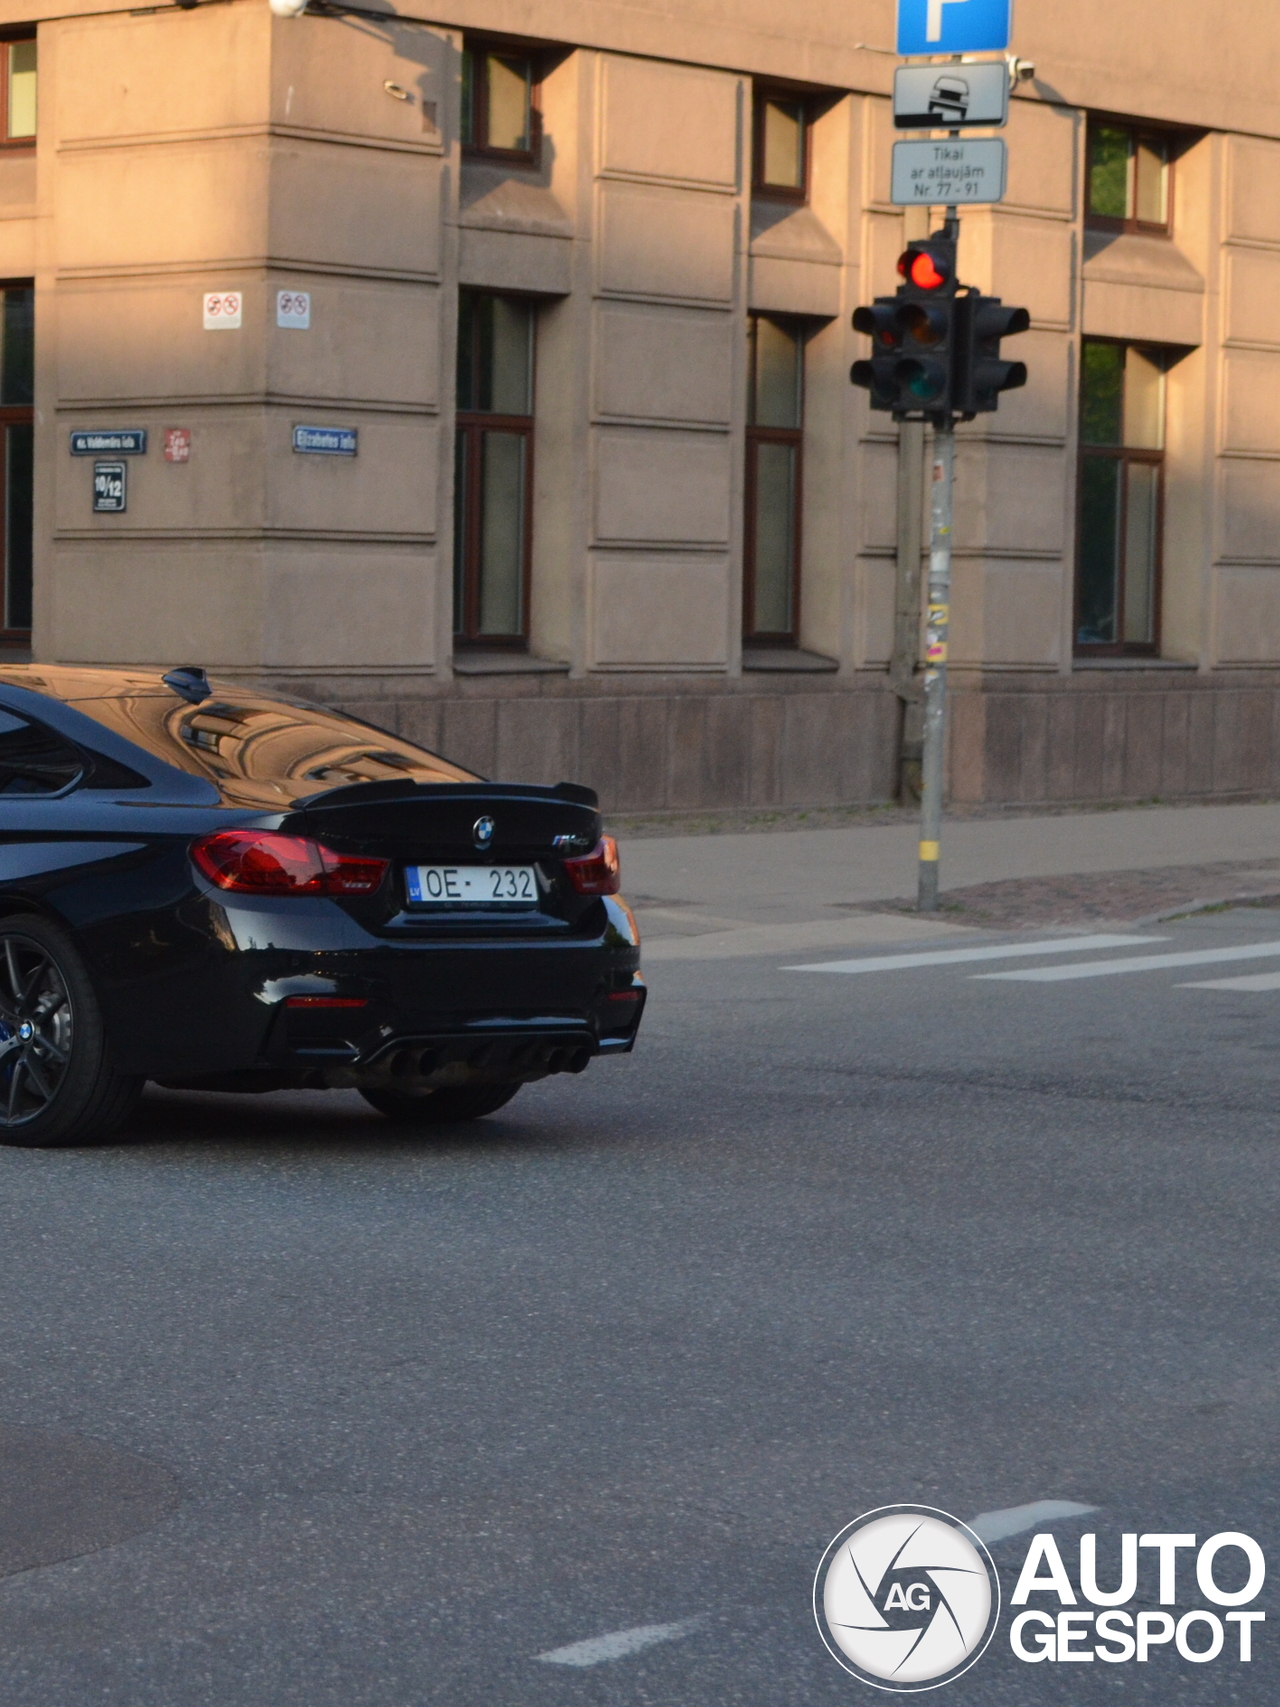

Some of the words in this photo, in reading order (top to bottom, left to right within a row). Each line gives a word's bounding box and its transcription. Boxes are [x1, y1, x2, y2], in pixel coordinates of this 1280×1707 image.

[934, 147, 964, 161] Tikai
[910, 169, 923, 179] ar
[937, 182, 951, 196] 77
[965, 182, 978, 195] 91
[95, 475, 122, 497] 10/12
[410, 888, 420, 896] LV
